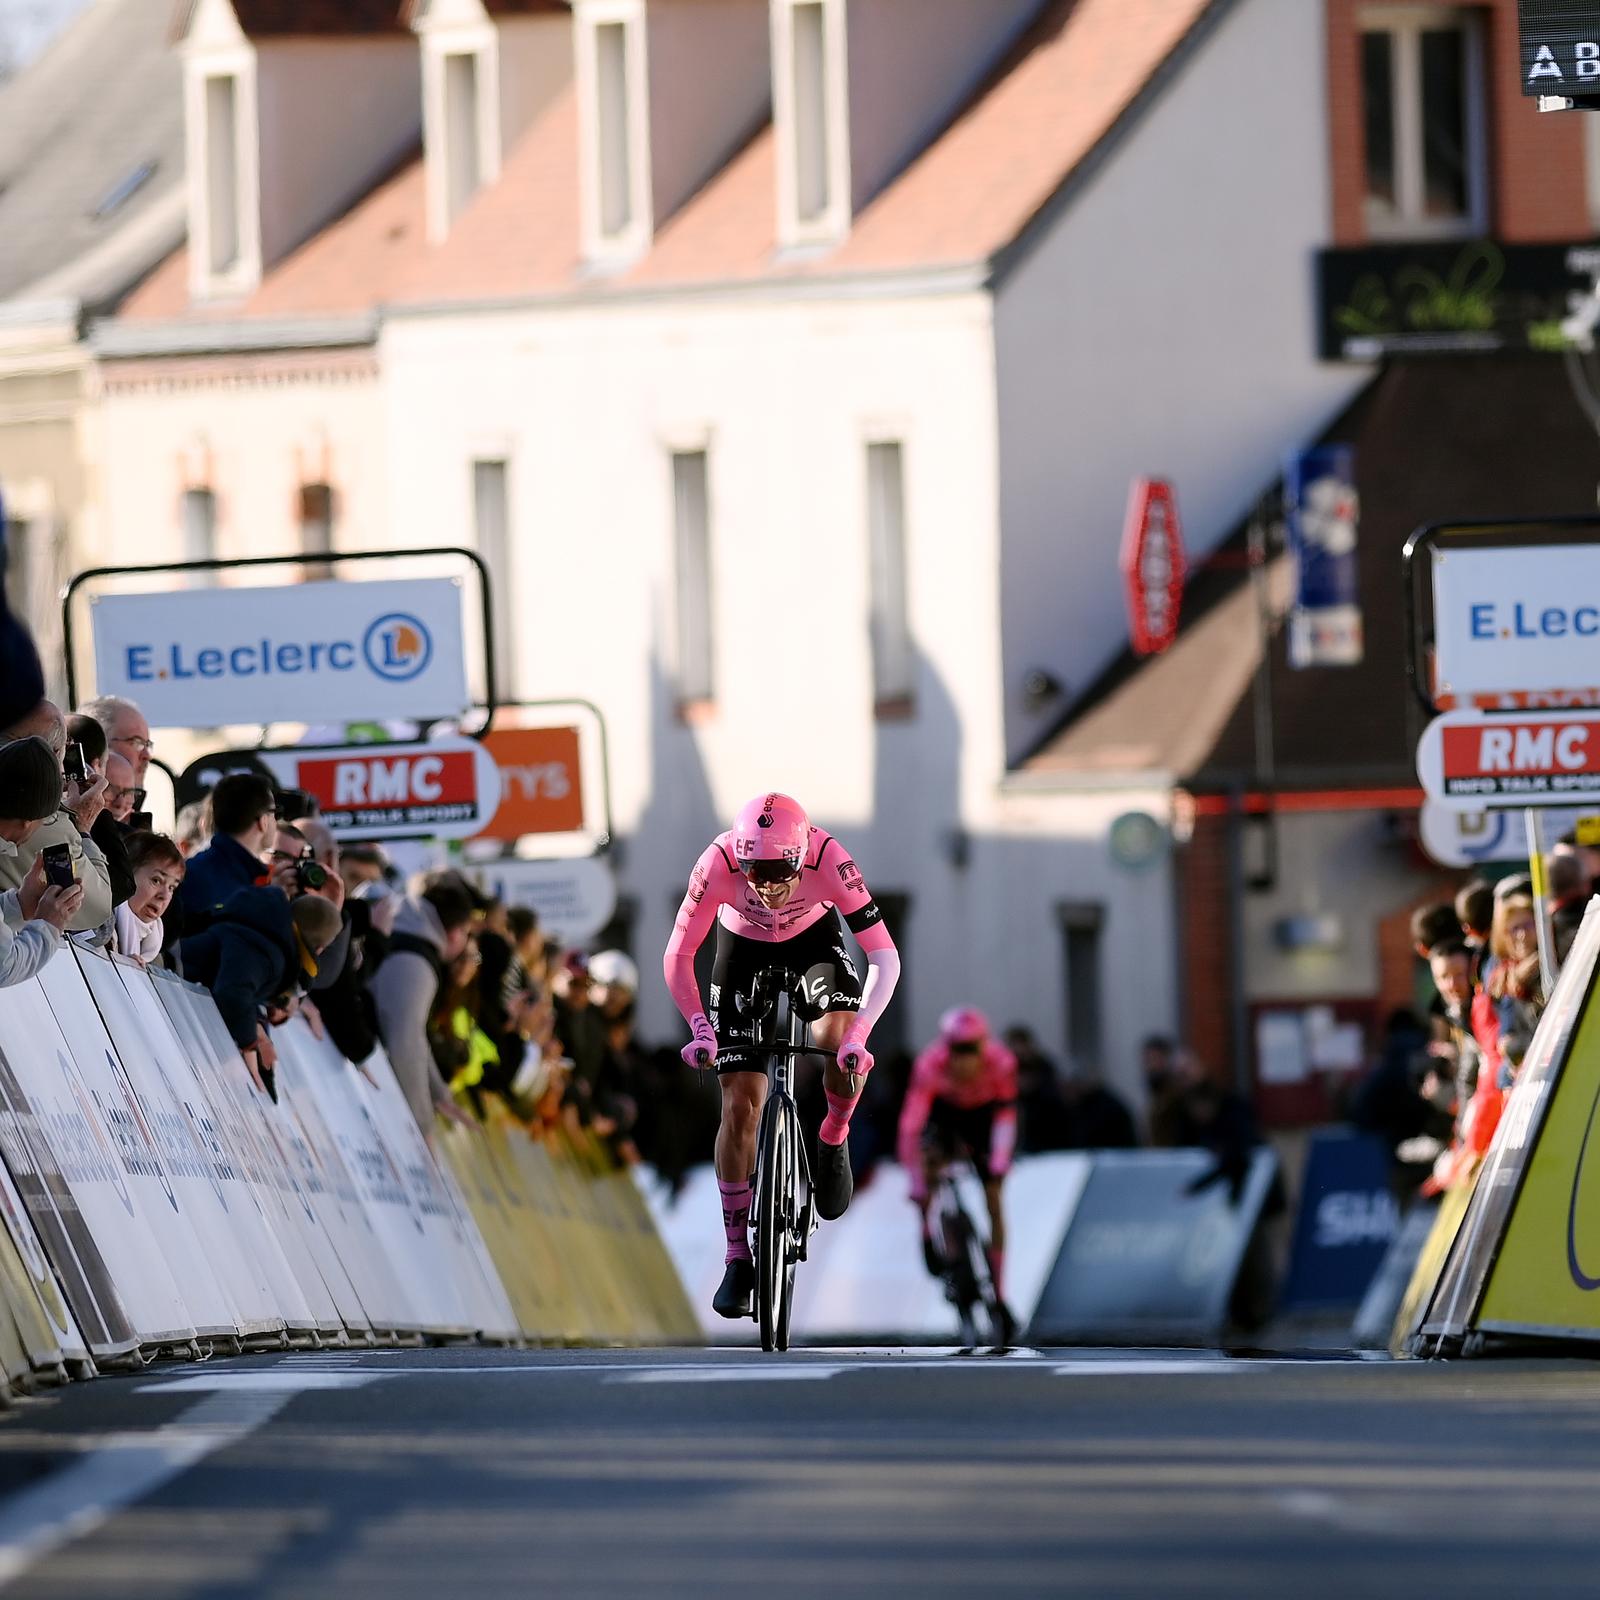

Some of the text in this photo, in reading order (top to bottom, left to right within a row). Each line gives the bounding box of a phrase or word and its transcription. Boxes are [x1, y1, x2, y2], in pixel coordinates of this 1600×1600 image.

[126, 639, 356, 681] E.Leclerc
[1479, 726, 1589, 771] RMC
[335, 756, 444, 806] RMC
